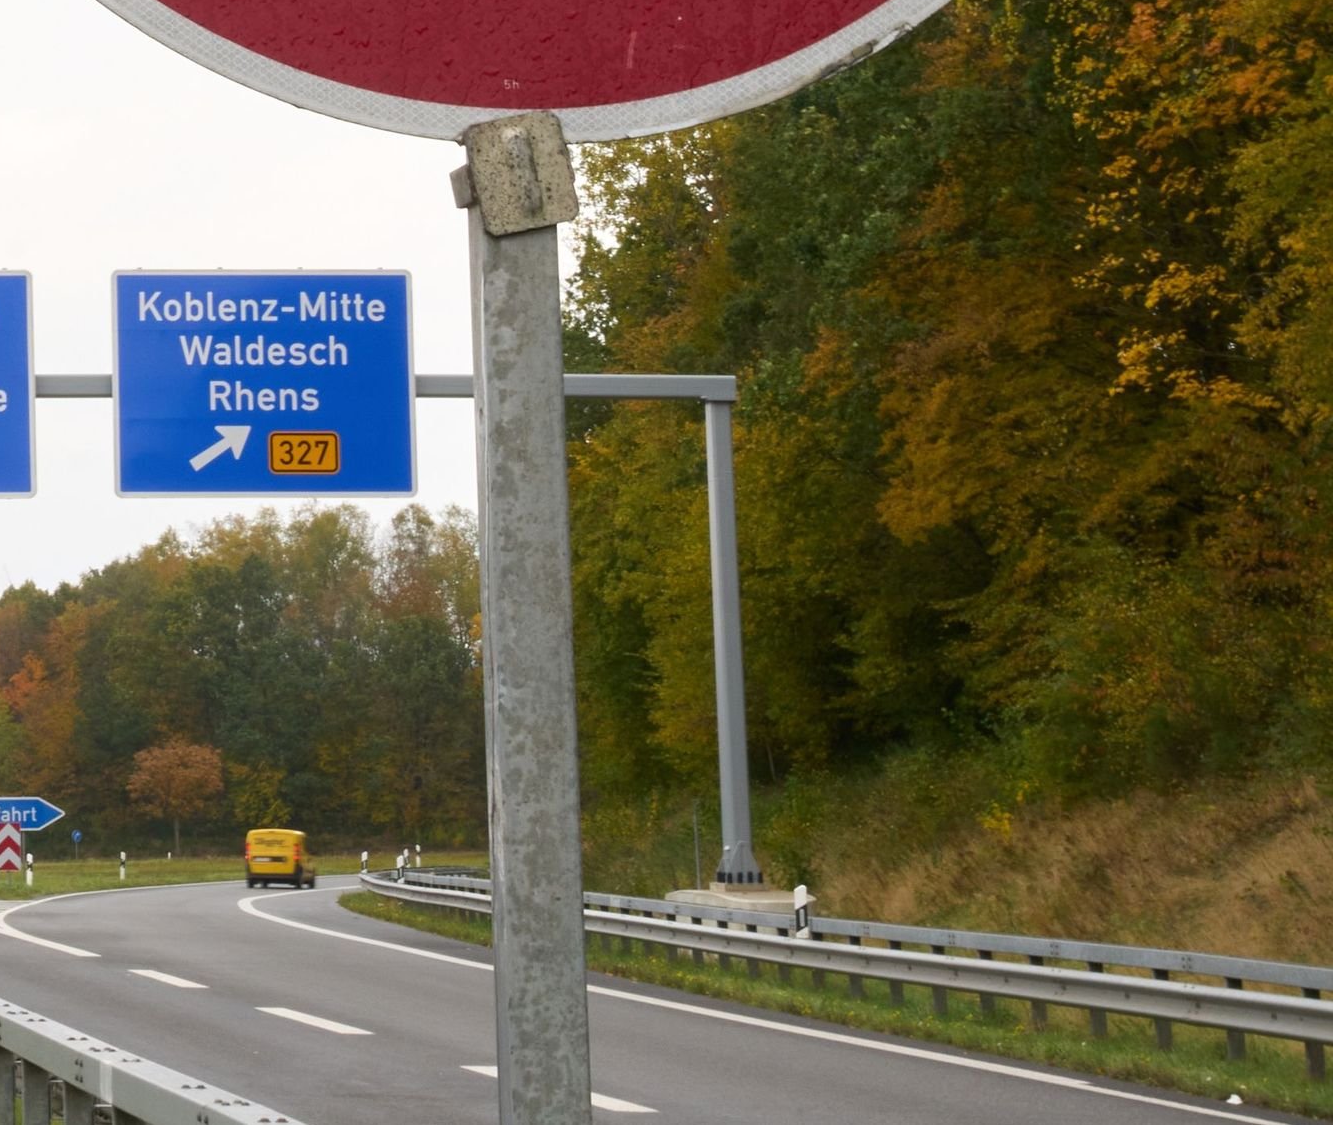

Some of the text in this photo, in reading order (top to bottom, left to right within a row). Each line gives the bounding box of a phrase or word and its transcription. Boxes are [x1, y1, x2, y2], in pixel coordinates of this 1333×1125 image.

[138, 291, 386, 322] Koblenz-Mitte
[179, 334, 348, 366] Waldesch
[209, 380, 319, 411] Rhens
[279, 440, 329, 465] 327
